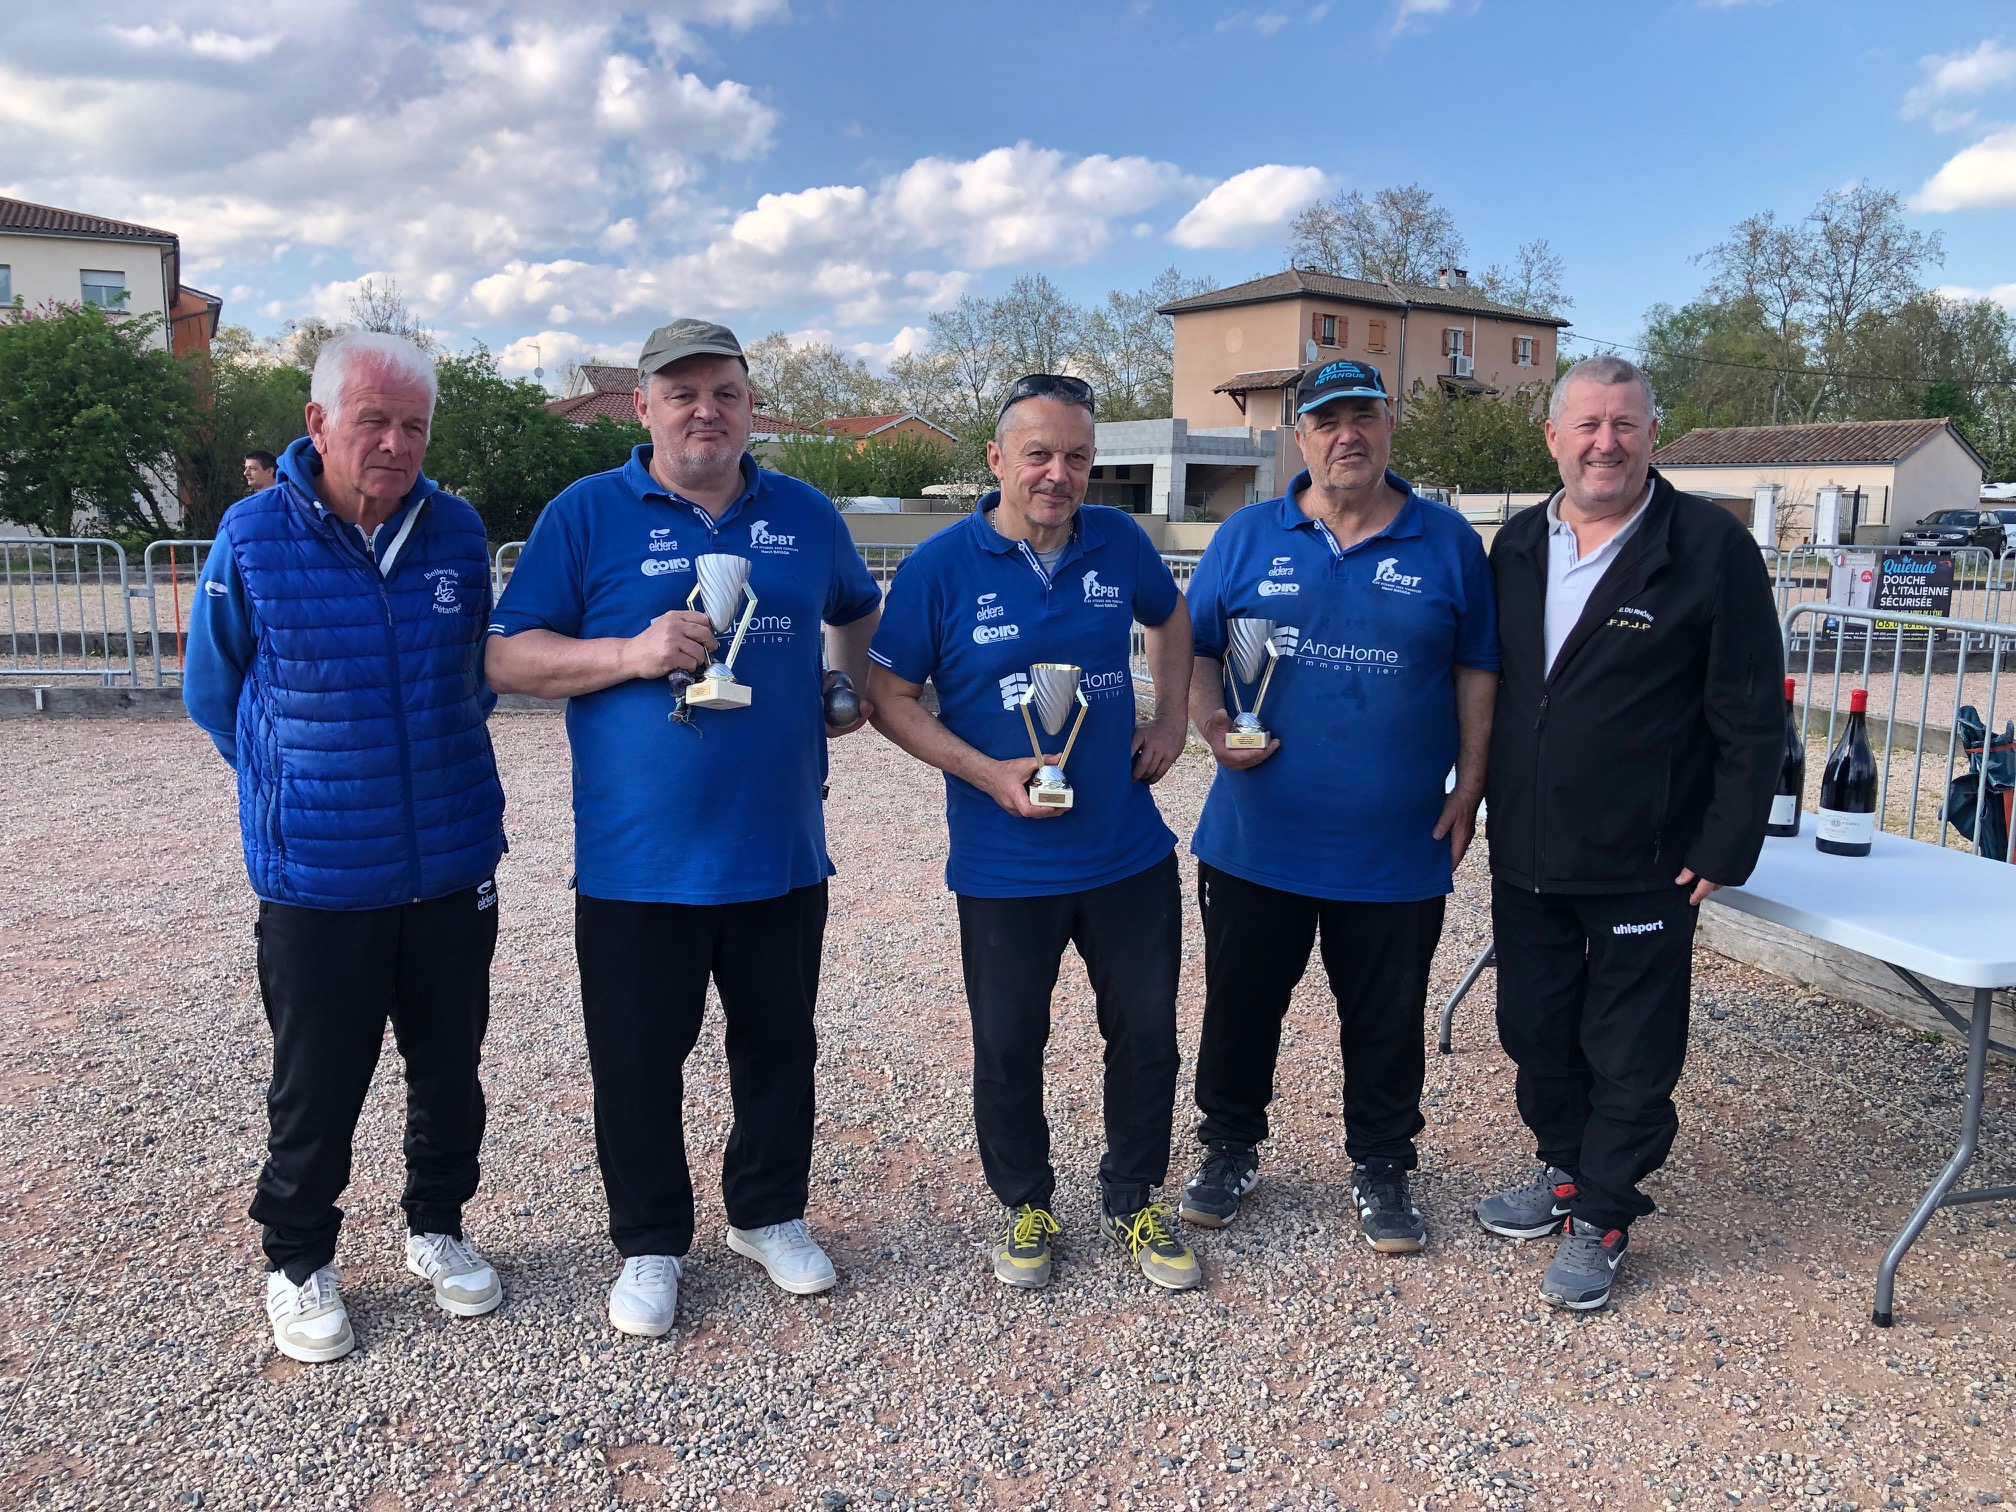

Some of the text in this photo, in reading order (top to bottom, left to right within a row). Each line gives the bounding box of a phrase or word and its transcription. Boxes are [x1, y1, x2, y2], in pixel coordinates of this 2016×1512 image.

[1318, 362, 1361, 379] MS
[1314, 373, 1366, 387] PETANQUE
[649, 539, 678, 552] eldera
[759, 534, 796, 546] CPBT
[424, 568, 459, 580] Belleville
[1268, 566, 1294, 576] eldera
[1382, 572, 1422, 587] CPBT
[1883, 575, 1926, 585] DOUCHE
[1091, 585, 1120, 598] CPBT
[1881, 584, 1949, 596] À L'ITALIENNE
[1880, 595, 1932, 607] SÉCURISÉE
[976, 605, 1004, 621] eldera
[1624, 606, 1634, 614] DU
[1633, 608, 1654, 622] RHÔNE
[1300, 638, 1399, 663] AnaHome
[1297, 657, 1398, 675] Immobilier
[477, 893, 497, 911] eldera
[1612, 920, 1664, 935] uhlsport
